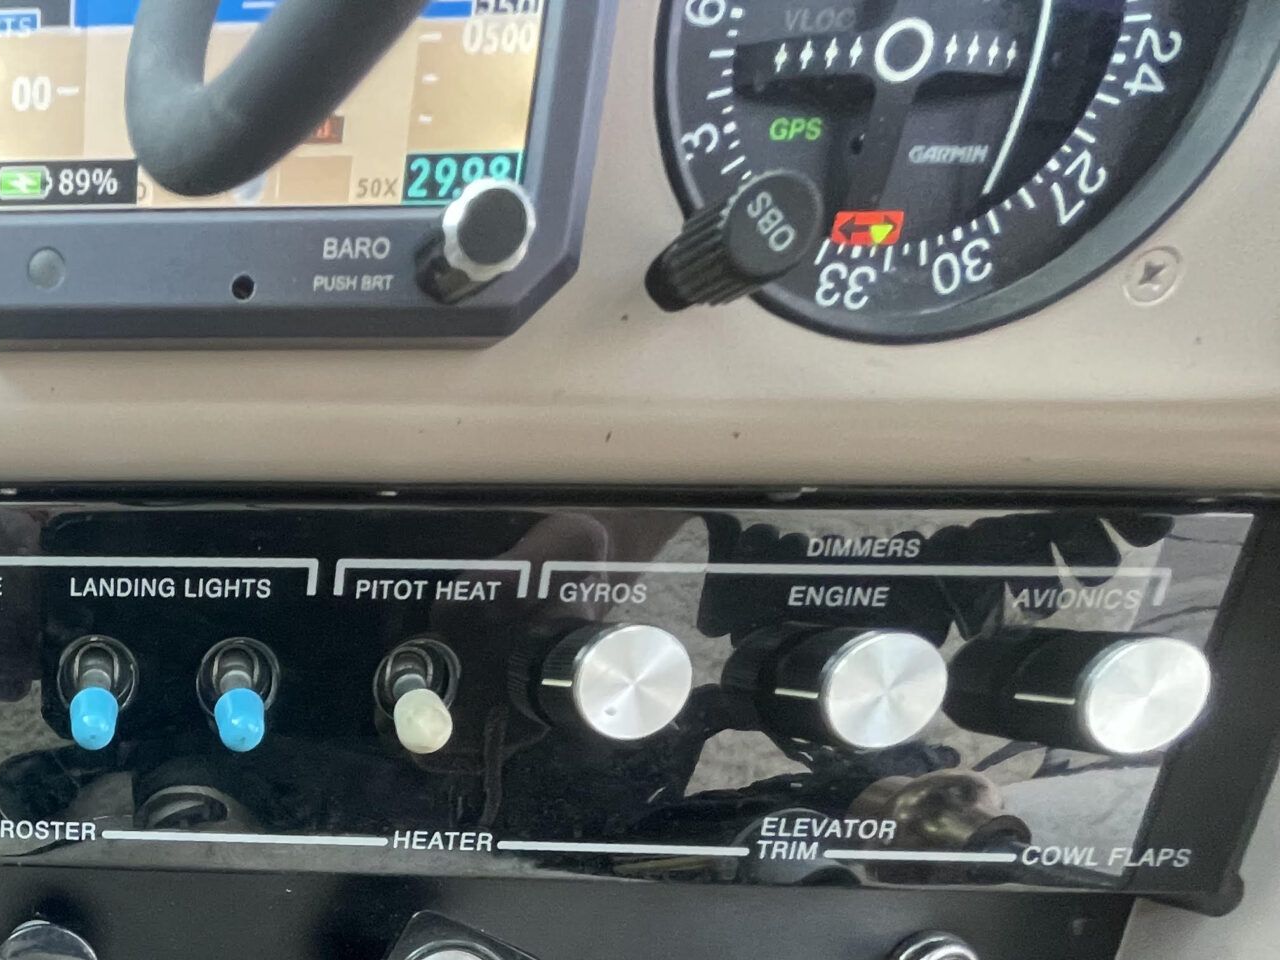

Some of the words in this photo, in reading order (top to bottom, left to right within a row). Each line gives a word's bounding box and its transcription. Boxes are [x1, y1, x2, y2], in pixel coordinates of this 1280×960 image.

[784, 7, 857, 33] VLOC
[463, 20, 536, 55] 0500
[1122, 27, 1183, 96] 24
[769, 116, 823, 141] GPS
[908, 145, 989, 164] GARMIN
[58, 167, 119, 197] 89%
[1049, 149, 1107, 226] 27
[746, 191, 797, 252] OBS
[322, 236, 391, 260] BARO
[931, 237, 993, 296] 30
[313, 274, 358, 292] PUSH
[360, 274, 395, 292] BRT
[814, 261, 877, 311] 33
[806, 537, 922, 560] DIMMERS
[70, 577, 177, 599] LANDING
[184, 578, 272, 600] LIGHTS
[355, 579, 431, 602] PITOT
[436, 580, 503, 603] HEAT
[559, 582, 648, 605] GYROS
[787, 585, 889, 608] ENGINE
[1012, 587, 1143, 611] AVIONICS
[760, 816, 897, 840] ELEVATOR
[392, 830, 494, 853] HEATER
[756, 840, 819, 862] TRIM
[1021, 844, 1101, 868] COWL
[1109, 845, 1192, 869] FLAPS
